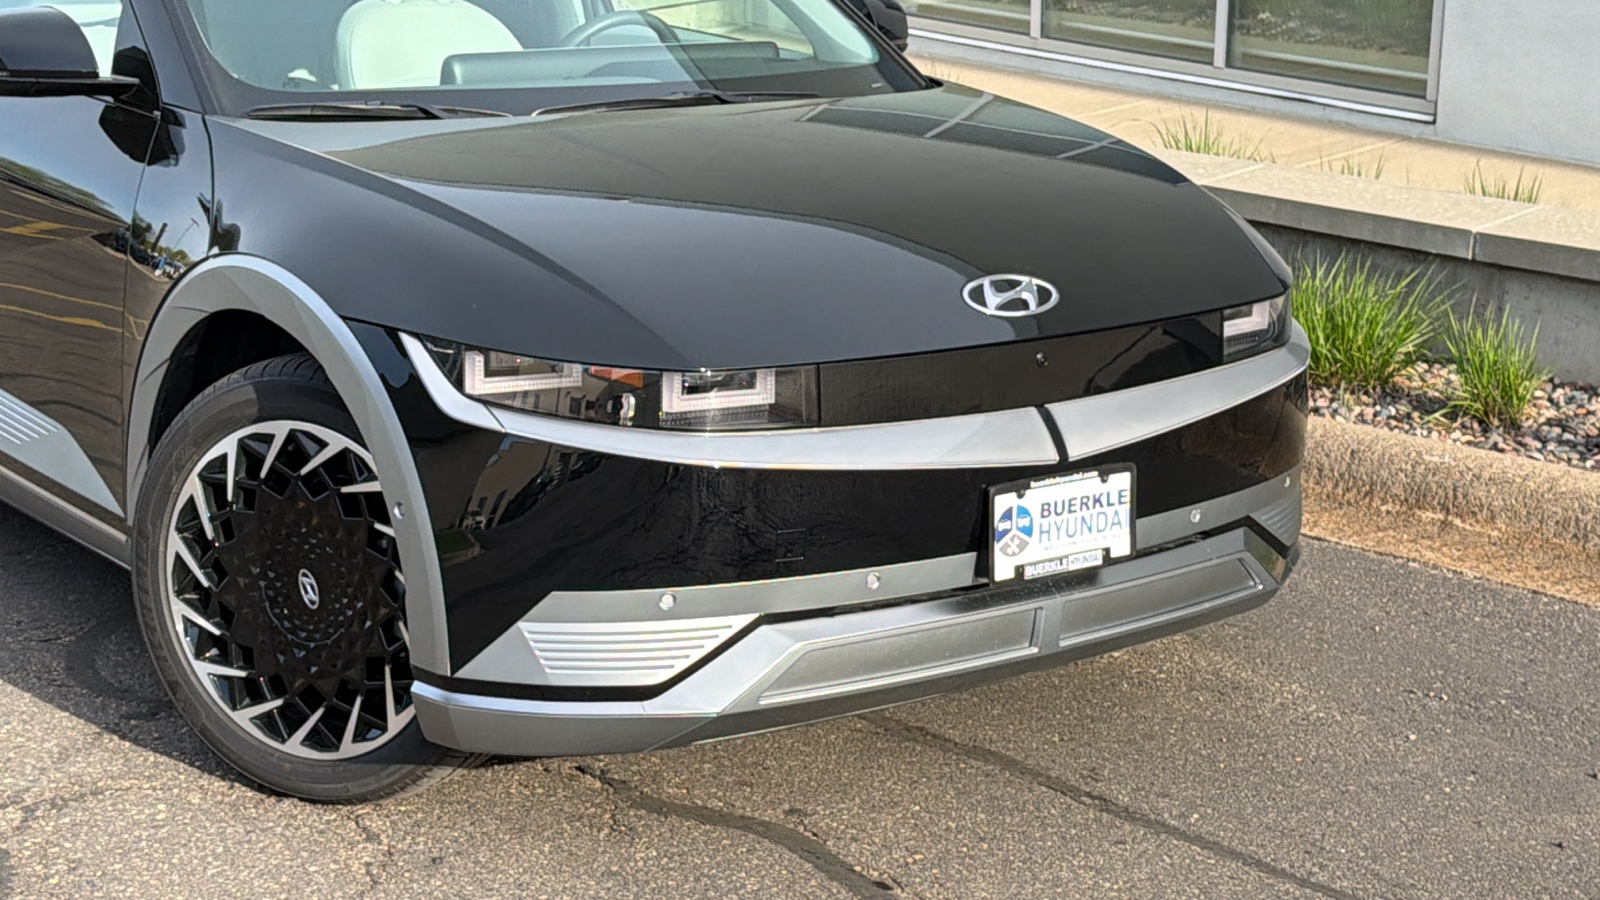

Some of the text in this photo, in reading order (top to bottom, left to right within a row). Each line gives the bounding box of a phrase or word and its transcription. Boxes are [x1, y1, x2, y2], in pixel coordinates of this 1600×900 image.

[1040, 489, 1129, 519] BUERKLE
[1038, 507, 1130, 545] HYUNDAI
[1025, 557, 1069, 577] BUERKLE
